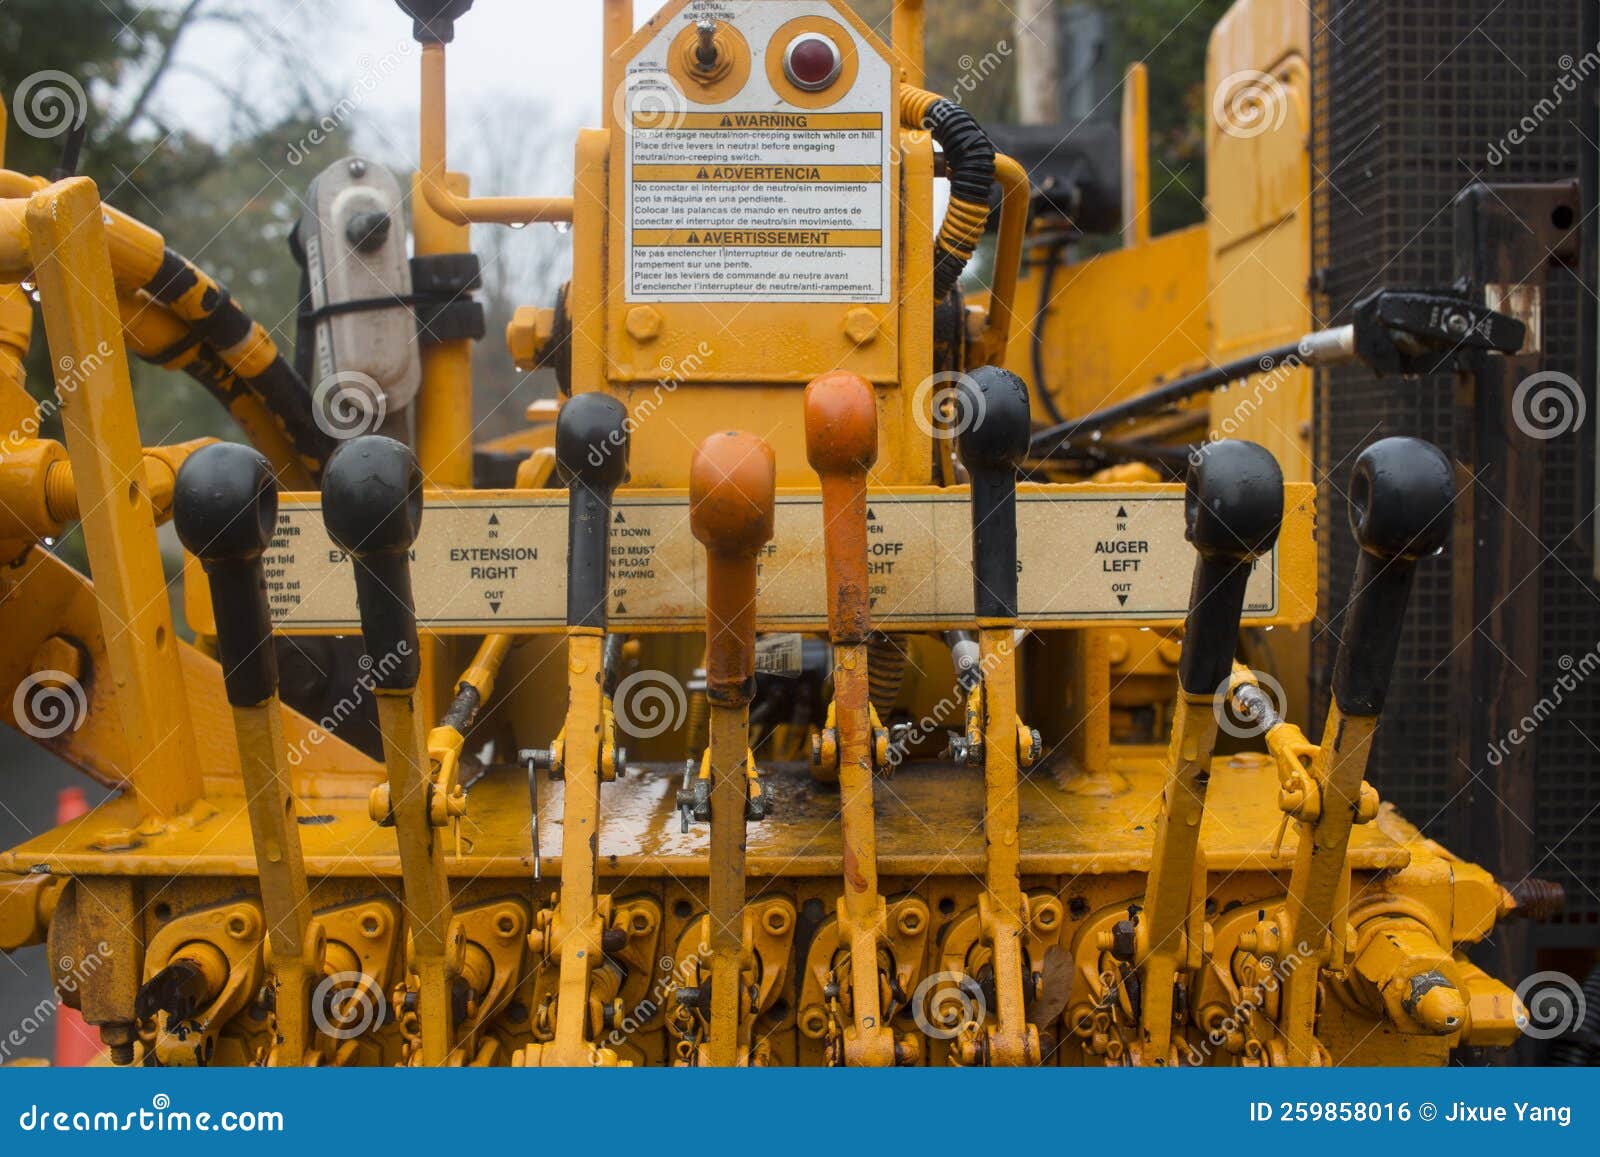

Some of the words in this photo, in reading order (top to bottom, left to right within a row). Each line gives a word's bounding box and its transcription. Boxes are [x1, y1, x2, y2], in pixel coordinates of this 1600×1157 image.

[735, 116, 807, 127] WARNING
[665, 131, 696, 141] engage
[792, 131, 821, 141] switch
[823, 131, 845, 141] while
[847, 131, 859, 141] on
[861, 131, 877, 141] hill.
[634, 142, 659, 152] Place
[661, 142, 683, 152] drive
[686, 142, 713, 152] levers
[716, 142, 724, 152] in
[728, 142, 758, 152] neutral
[761, 142, 790, 152] before
[793, 142, 835, 152] engaging
[730, 153, 762, 162] switch.
[713, 167, 820, 179] ADVERTENCIA
[634, 184, 646, 193] No
[649, 184, 688, 193] conectar
[691, 184, 699, 193] el
[701, 184, 750, 193] interruptor
[752, 184, 764, 193] de
[766, 184, 812, 193] neutro/sin
[814, 184, 867, 193] movimiento
[634, 194, 651, 203] con
[654, 194, 661, 203] la
[705, 194, 716, 203] en
[719, 194, 736, 203] una
[738, 194, 786, 203] pendiente.
[634, 206, 669, 215] Colocar
[672, 206, 685, 215] las
[687, 206, 728, 215] palancas
[730, 206, 742, 215] de
[744, 206, 775, 215] mando
[778, 206, 789, 215] en
[792, 206, 820, 215] neutro
[823, 206, 847, 215] antes
[850, 206, 861, 215] de
[634, 217, 673, 226] conectar
[676, 217, 683, 226] el
[686, 217, 734, 226] interruptor
[737, 217, 749, 226] de
[751, 217, 797, 226] neutro/sin
[703, 232, 829, 244] AVERTISSEMENT
[634, 249, 646, 259] Ne
[649, 249, 664, 259] pas
[667, 249, 717, 259] enclencher
[781, 249, 792, 259] de
[634, 260, 685, 270] rampement
[687, 260, 702, 270] sur
[704, 260, 721, 270] une
[724, 260, 752, 270] pente.
[634, 271, 662, 280] Placer
[665, 271, 678, 280] les
[680, 271, 710, 280] leviers
[713, 271, 724, 280] de
[726, 271, 776, 280] commande
[779, 271, 790, 280] au
[793, 271, 821, 280] neutre
[824, 271, 848, 280] avant
[755, 282, 767, 292] de
[276, 527, 300, 535] OWER
[1116, 523, 1126, 531] IN
[488, 530, 498, 538] IN
[621, 528, 651, 537] DOWN
[628, 546, 655, 555] MUST
[1094, 541, 1149, 553] AUGER
[450, 548, 538, 561] EXTENSION
[619, 558, 650, 567] FLOAT
[1103, 559, 1141, 572] LEFT
[471, 566, 518, 579] RIGHT
[619, 570, 654, 578] PAVING
[286, 581, 300, 589] out
[1112, 583, 1132, 592] OUT
[484, 591, 504, 599] OUT
[614, 588, 627, 597] UP
[270, 593, 300, 604] raising
